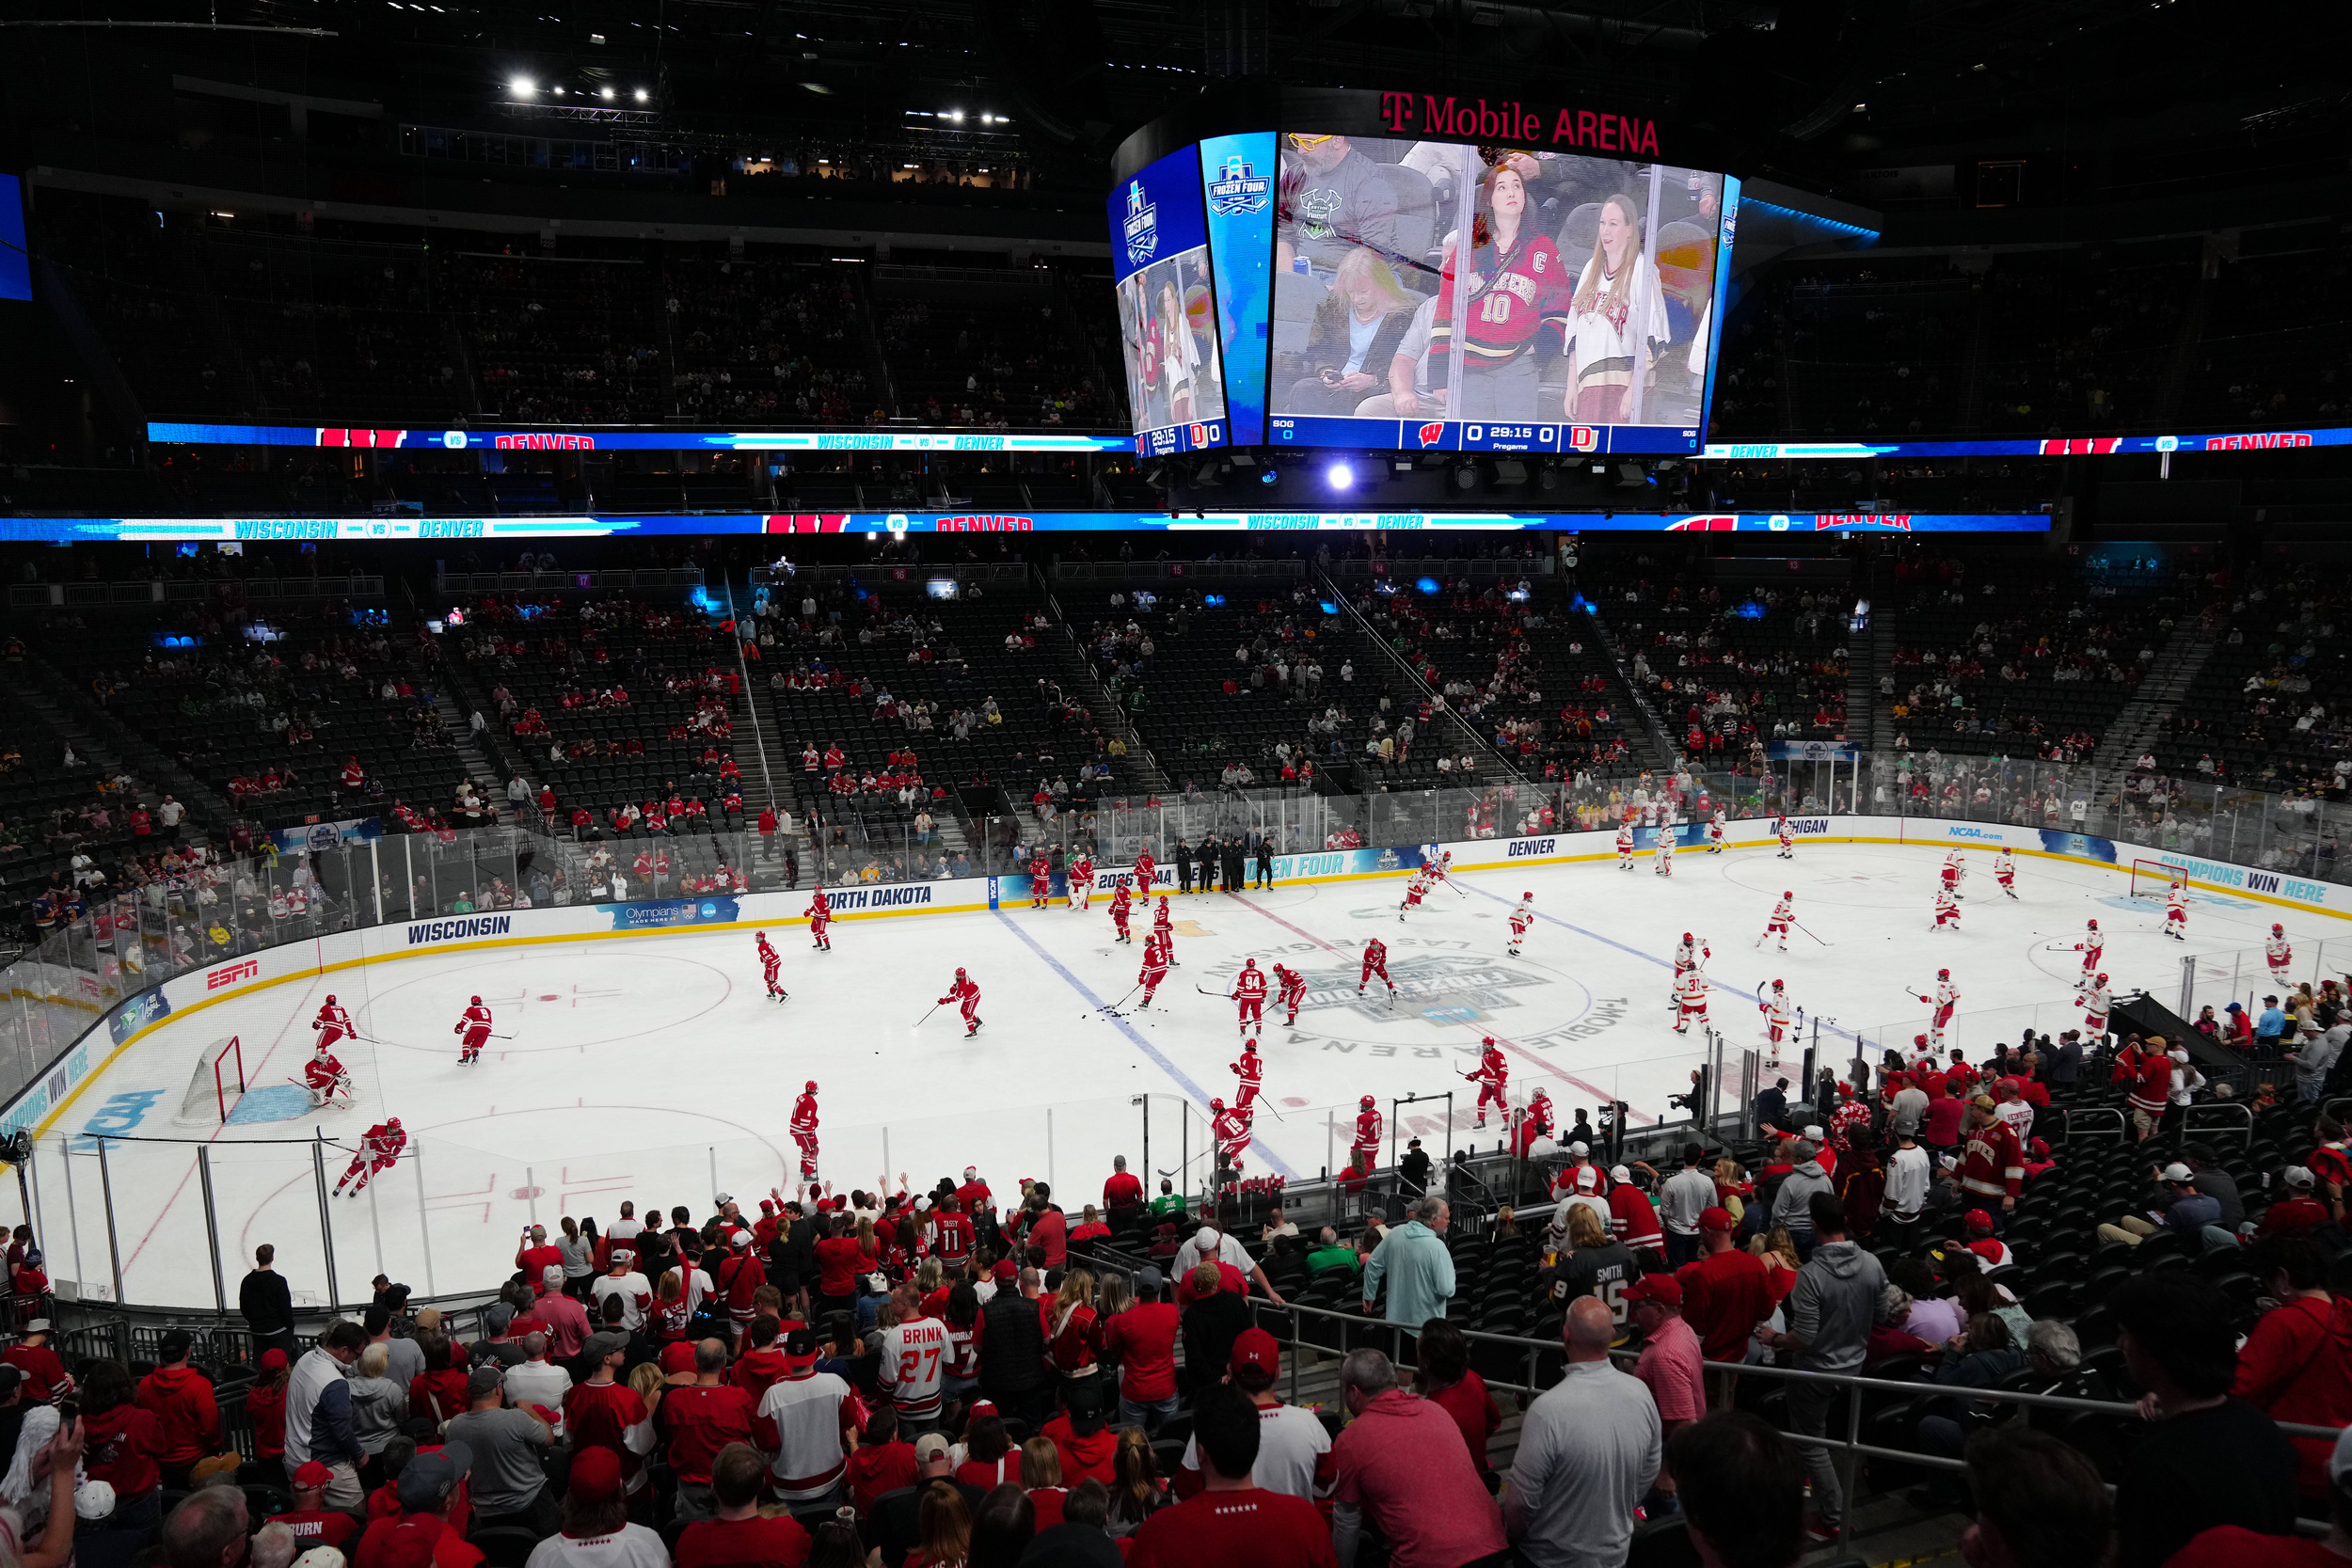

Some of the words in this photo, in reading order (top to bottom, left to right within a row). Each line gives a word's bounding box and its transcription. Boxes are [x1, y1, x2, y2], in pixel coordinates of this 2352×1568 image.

[1422, 95, 1541, 142] Mobile
[1551, 107, 1661, 157] ARENA
[1213, 183, 1241, 198] FROZEN
[1241, 182, 1265, 194] FOUR
[1127, 217, 1142, 241] FROZEN
[1141, 211, 1154, 231] FOUR
[1480, 293, 1511, 325] 10
[1209, 424, 1220, 442] 0
[1272, 420, 1295, 430] SOG
[450, 433, 462, 445] VS
[1152, 427, 1176, 447] 29:15
[1282, 430, 1294, 440] 0
[1467, 425, 1483, 441] 0
[1489, 427, 1533, 438] 29:15
[1538, 427, 1553, 443] 0
[818, 436, 894, 450] WISCONSIN
[920, 437, 930, 447] VS
[954, 436, 1004, 451] DENVER
[1154, 445, 1175, 456] Pregame
[1492, 442, 1529, 451] Pregame
[1689, 439, 1697, 449] 0
[1729, 445, 1778, 458] DENVER
[2162, 439, 2173, 450] VS
[234, 520, 340, 539] WISCONSIN
[373, 523, 387, 535] VS
[418, 520, 485, 538] DENVER
[892, 518, 903, 528] VS
[1247, 515, 1319, 530] WISCONSIN
[1343, 516, 1354, 526] VS
[1375, 515, 1424, 529] DENVER
[1773, 519, 1785, 528] VS
[895, 570, 905, 580] 16
[1172, 565, 1182, 575] 15
[1375, 564, 1384, 573] 14
[579, 576, 588, 586] 17
[1133, 697, 1139, 705] 9
[1770, 819, 1829, 836] MHIGAN
[1948, 827, 2003, 841] NCAA.com
[1508, 838, 1555, 857] DENVER
[1298, 854, 1344, 876] FOUR
[2159, 854, 2244, 886] CHAMPIONS
[2247, 871, 2280, 894] WIN
[2282, 879, 2327, 903] HERE
[827, 889, 867, 910] ORTH
[871, 886, 931, 906] DAKOTA
[69, 910, 77, 923] 3
[625, 906, 679, 921] Olympians
[407, 915, 511, 945] WISCONSIN
[1396, 938, 1471, 949] LAS
[1155, 950, 1164, 963] 2
[207, 958, 258, 991] ESPN
[1245, 976, 1260, 990] 94
[1689, 979, 1700, 992] 31
[481, 1008, 490, 1020] 9
[1521, 997, 1629, 1050] T-MOBILE
[1286, 1033, 1484, 1058] ARENA
[48, 1065, 67, 1105] WIN
[68, 1048, 88, 1086] HERE
[1224, 1116, 1245, 1136] 19
[943, 1220, 959, 1228] TASSY
[943, 1229, 960, 1252] 11
[1597, 1264, 1623, 1284] SMITH
[1553, 1279, 1568, 1300] 9
[1594, 1278, 1629, 1325] 19
[903, 1326, 944, 1345] BRINK
[898, 1347, 941, 1385] 27
[961, 1343, 978, 1375] 7
[288, 1521, 324, 1538] BURN
